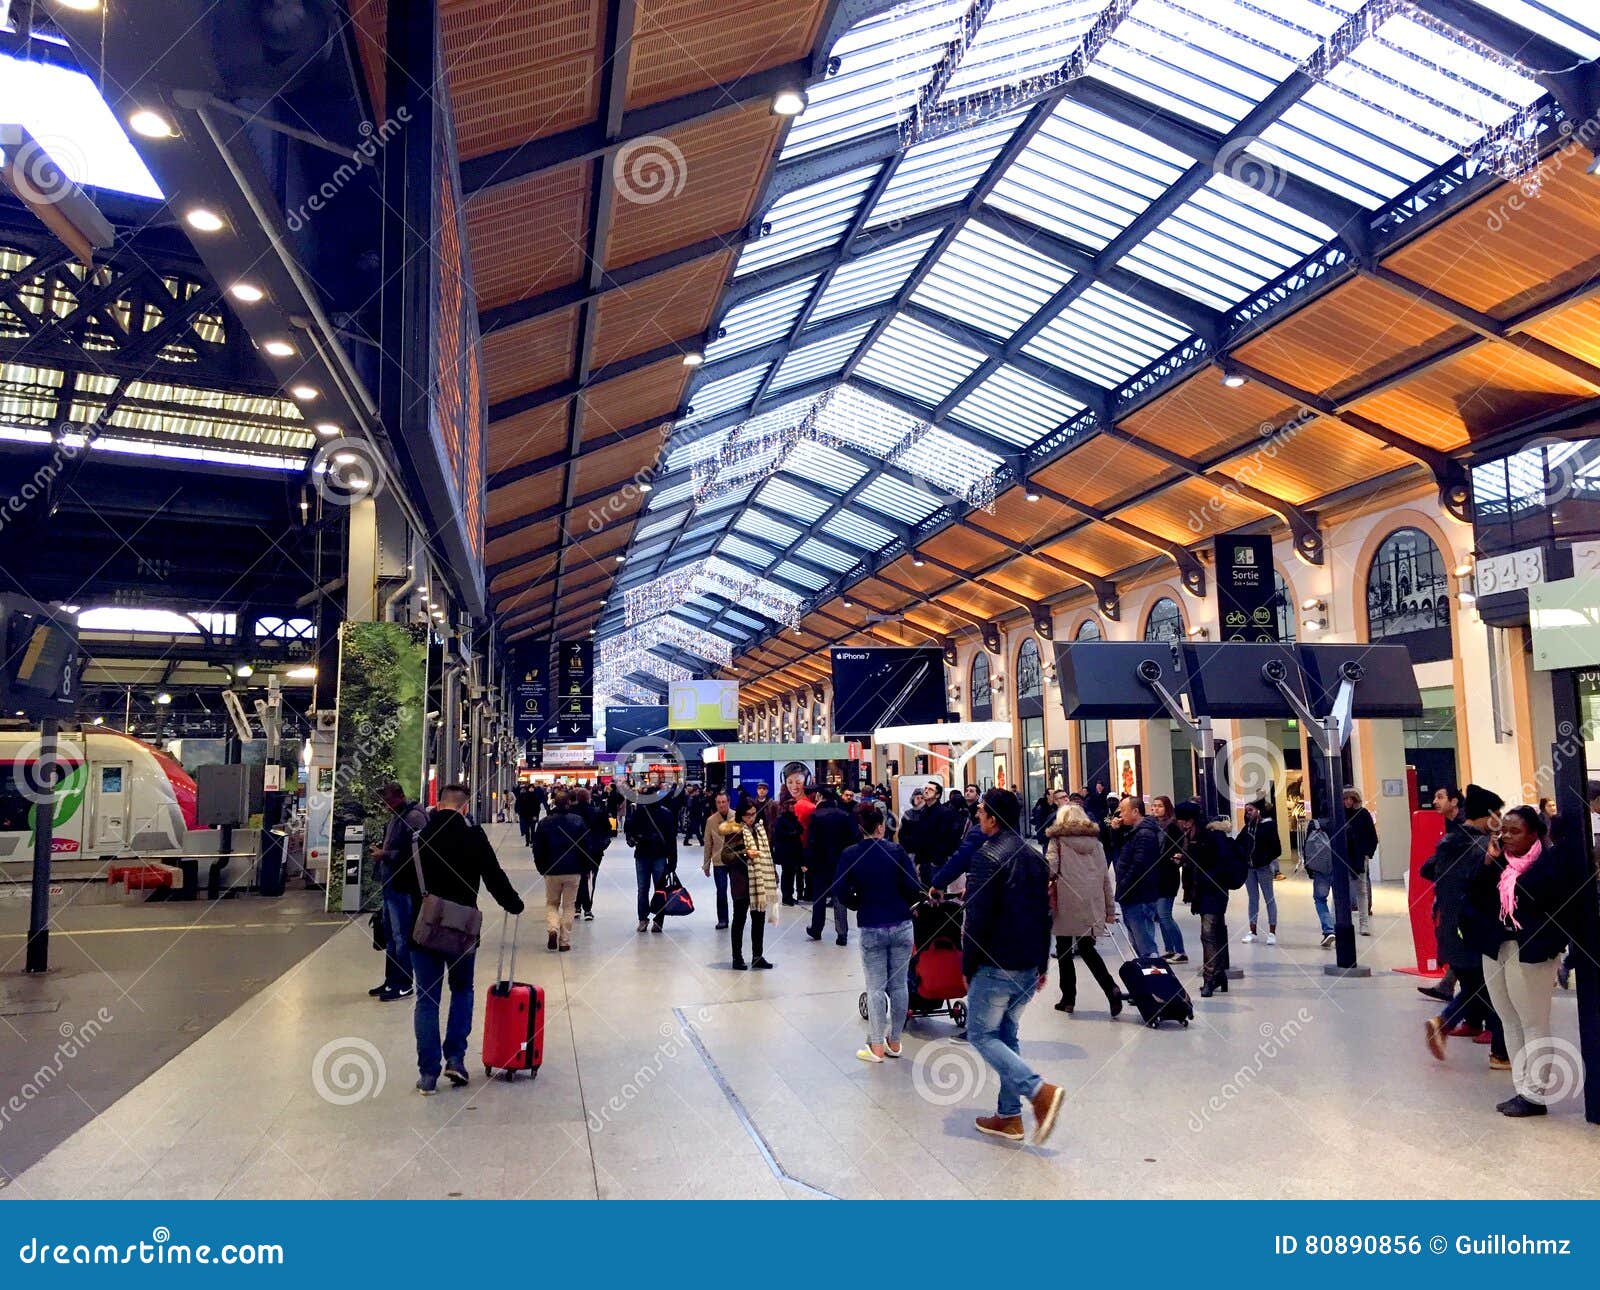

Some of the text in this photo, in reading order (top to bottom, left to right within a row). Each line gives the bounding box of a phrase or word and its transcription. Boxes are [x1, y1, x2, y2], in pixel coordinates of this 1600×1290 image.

[1231, 570, 1260, 580] Sortie
[1255, 611, 1268, 619] BUS
[842, 652, 865, 660] iPhone
[50, 841, 78, 851] SNCF
